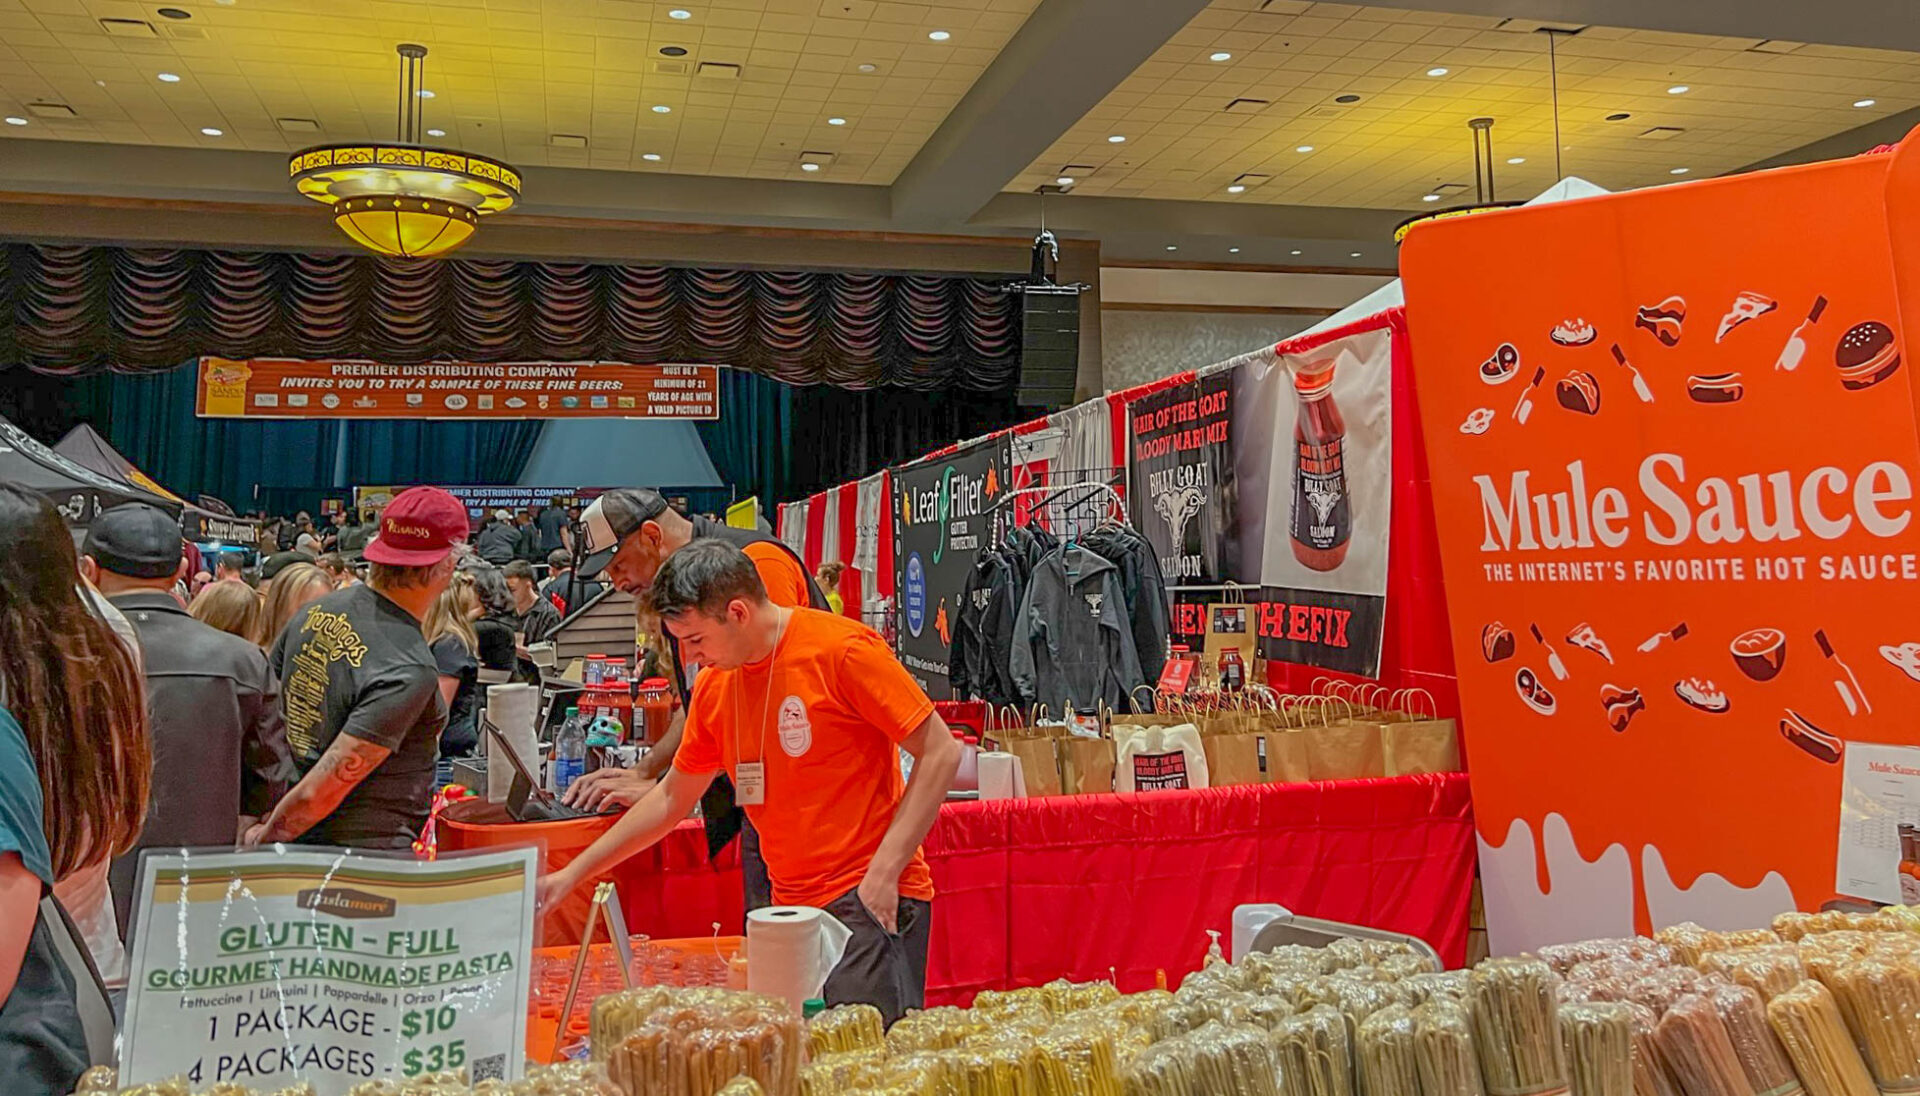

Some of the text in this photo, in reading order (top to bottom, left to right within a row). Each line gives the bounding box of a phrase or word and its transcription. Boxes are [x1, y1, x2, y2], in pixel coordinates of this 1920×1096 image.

[331, 365, 578, 377] PREMIER DISTRIBUTING COMPANY
[663, 366, 698, 376] MUST BE A
[280, 377, 623, 391] INVITES YOU TO TRY A SAMPLE OF THESE FINE BEERS:
[654, 379, 706, 388] MINIMUM OF 21
[648, 392, 712, 402] YEARS OF AGE WITH
[648, 404, 712, 415] A VALID PICTURE ID
[1134, 390, 1228, 436] HAIR OF THE GOAT
[1206, 420, 1228, 446] MIX
[1150, 461, 1208, 498] BILLY GOAT
[465, 498, 479, 506] TRY
[473, 489, 532, 497] DISTRIBUTING
[534, 489, 575, 497] COMPANY
[913, 473, 982, 525] Leaf Filter
[1472, 452, 1913, 552] Mule Sauce
[894, 478, 902, 556] ZERO
[950, 520, 968, 535] GUTTER
[950, 535, 978, 550] PROTECTION
[1160, 555, 1201, 578] SALOON
[1483, 554, 1917, 582] THE INTERNET'S FAVORITE HOT SAUCE
[220, 921, 354, 955] GLUTEN
[387, 928, 460, 956] FULL
[148, 951, 513, 989] GOURMET HANDMADE PASTA
[324, 984, 388, 1006] Pappardelle
[404, 993, 435, 1004] Orzo
[209, 1016, 218, 1042] 1
[235, 1004, 376, 1038] PACKAGE
[401, 1004, 457, 1041] $10
[188, 1056, 203, 1084] 4
[217, 1044, 375, 1082] PACKAGES
[402, 1040, 466, 1078] $35
